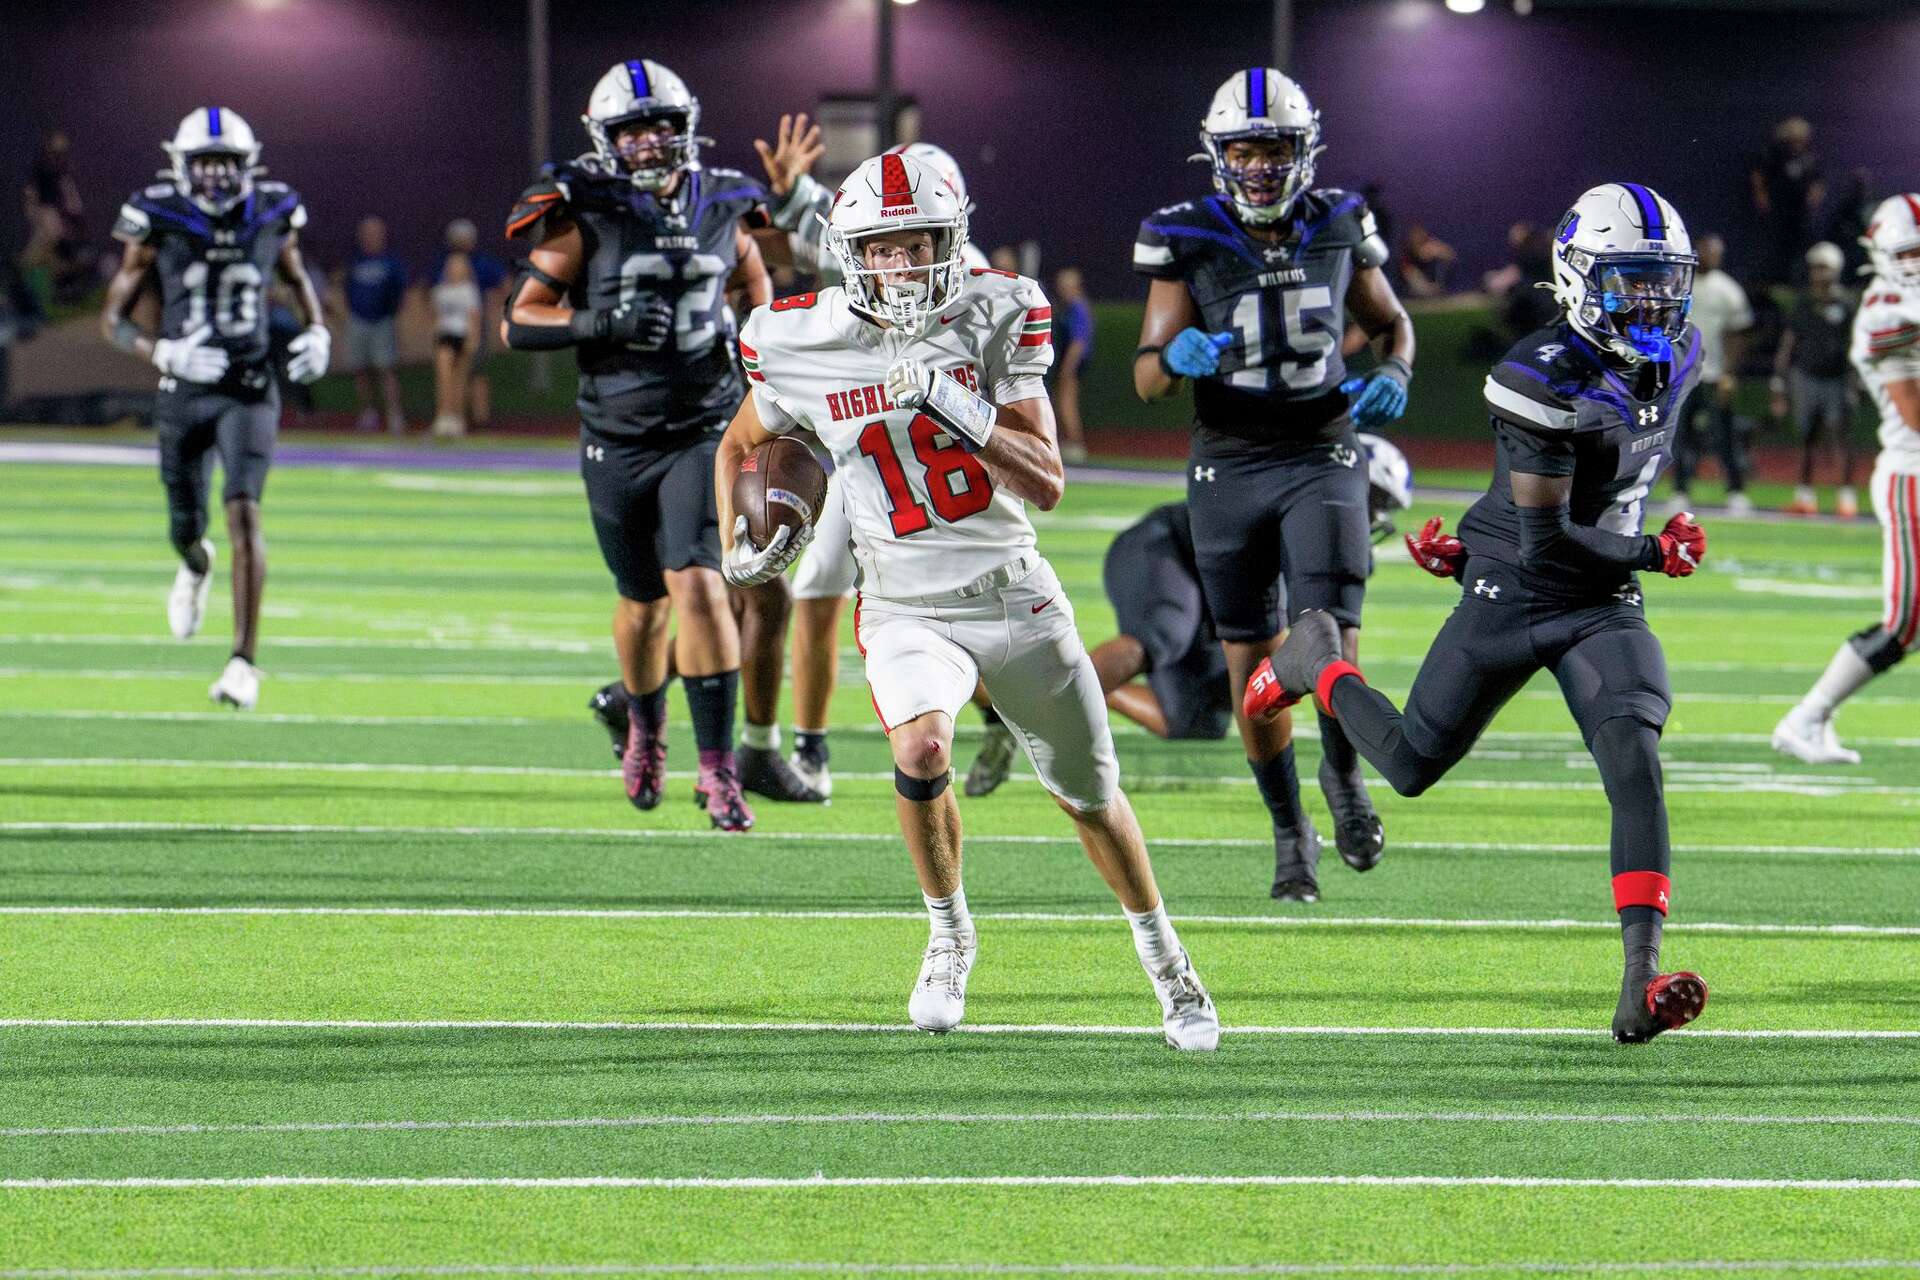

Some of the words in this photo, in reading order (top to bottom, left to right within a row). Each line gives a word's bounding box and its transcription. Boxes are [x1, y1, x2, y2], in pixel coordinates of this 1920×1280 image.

[881, 206, 917, 217] Riddell
[182, 262, 261, 336] 10
[1232, 286, 1335, 389] 15
[1535, 343, 1568, 362] 4
[857, 412, 994, 537] 18
